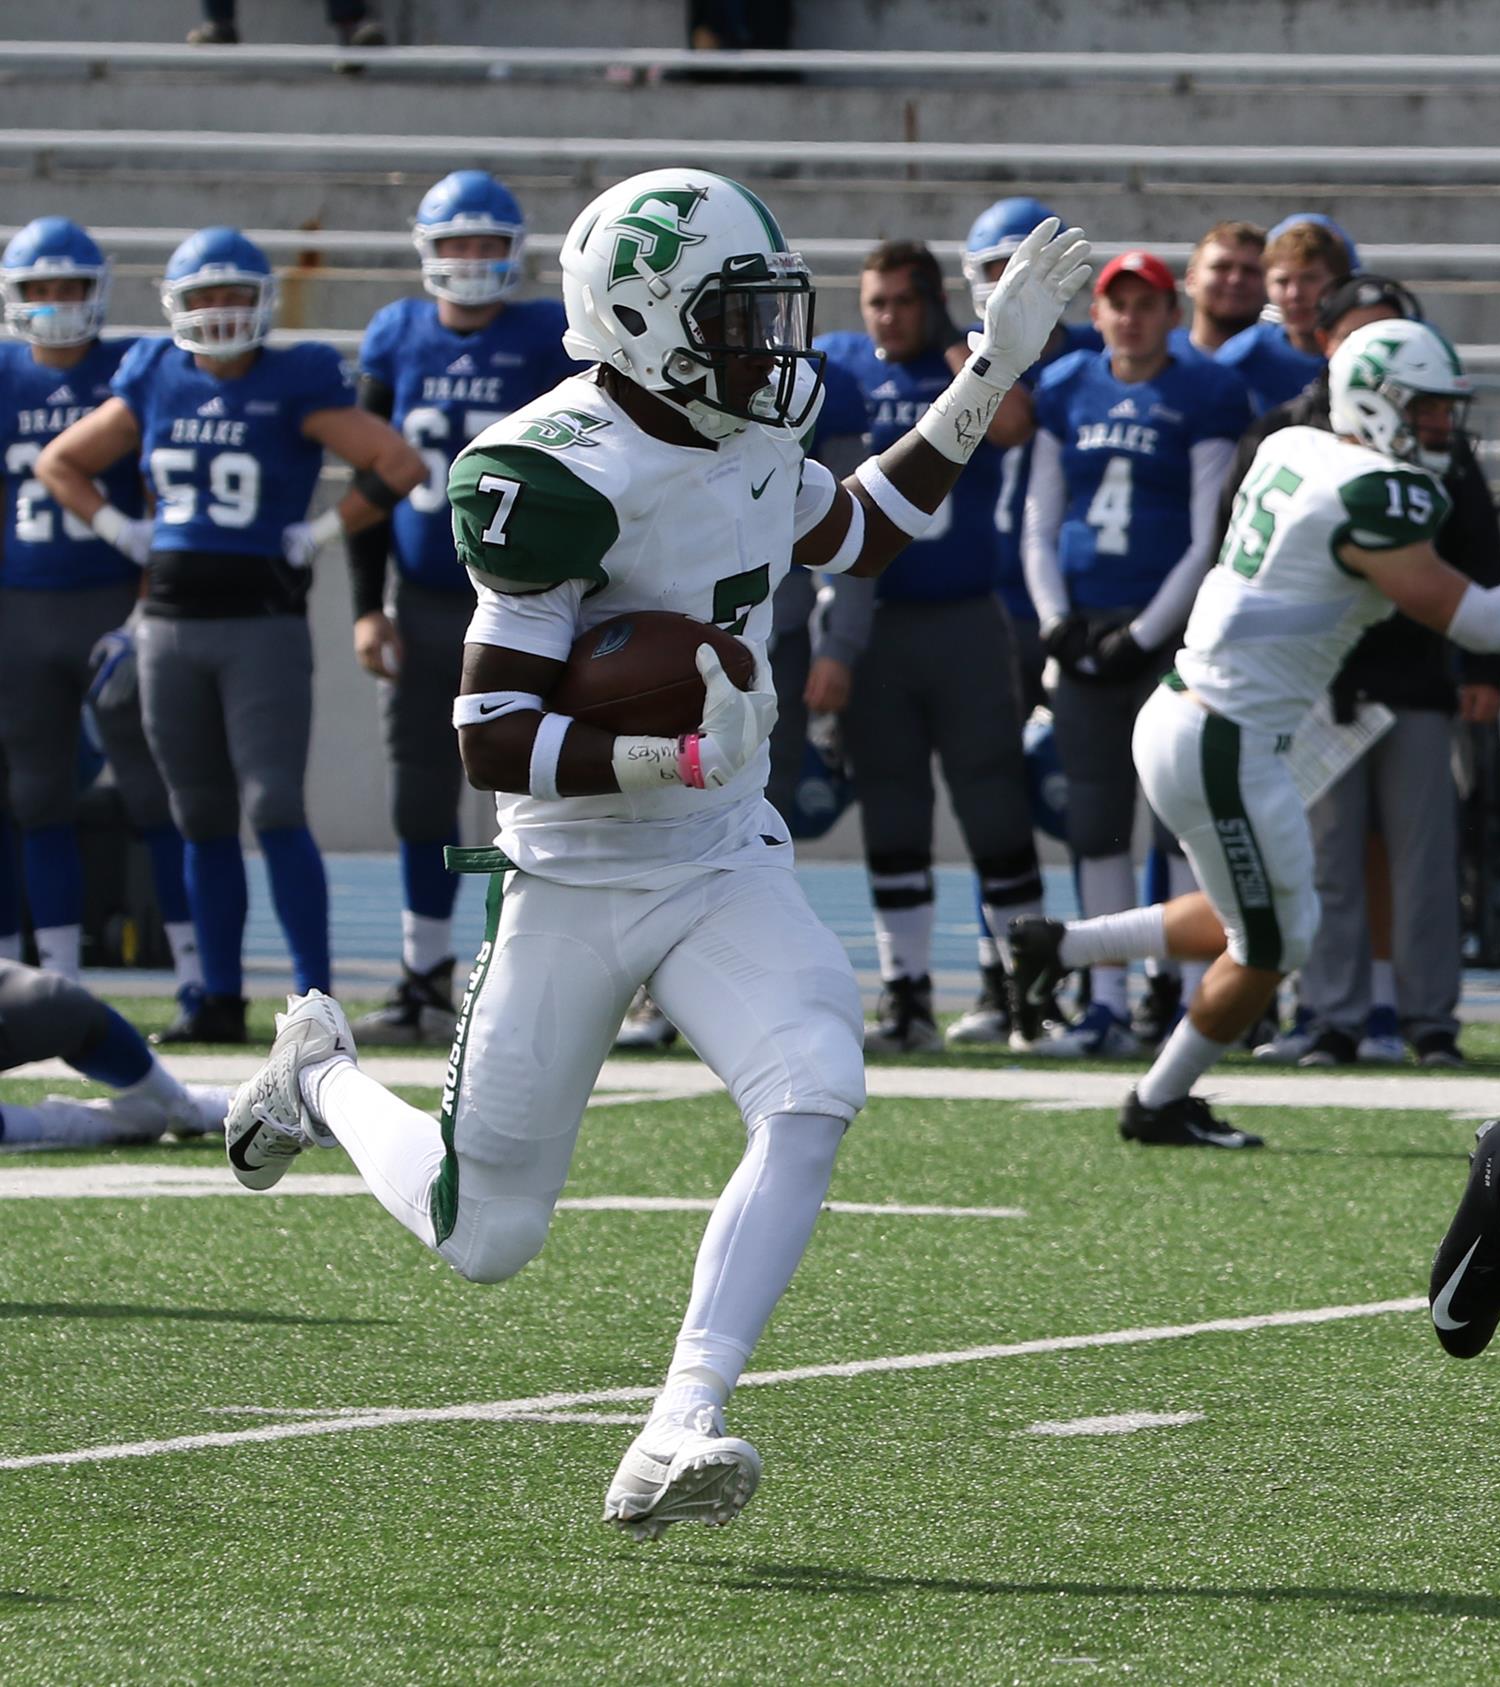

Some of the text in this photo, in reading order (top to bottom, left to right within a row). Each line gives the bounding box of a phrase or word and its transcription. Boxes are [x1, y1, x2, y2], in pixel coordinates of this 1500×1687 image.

[423, 376, 506, 403] DRAKE
[17, 406, 97, 434] DRAK
[170, 417, 248, 447] DRAKE
[1073, 422, 1159, 455] DRAKE
[151, 448, 260, 529] 59
[477, 473, 522, 546] 7
[1085, 455, 1133, 556] 4
[1385, 478, 1435, 525] 15
[1216, 817, 1272, 909] STETSON
